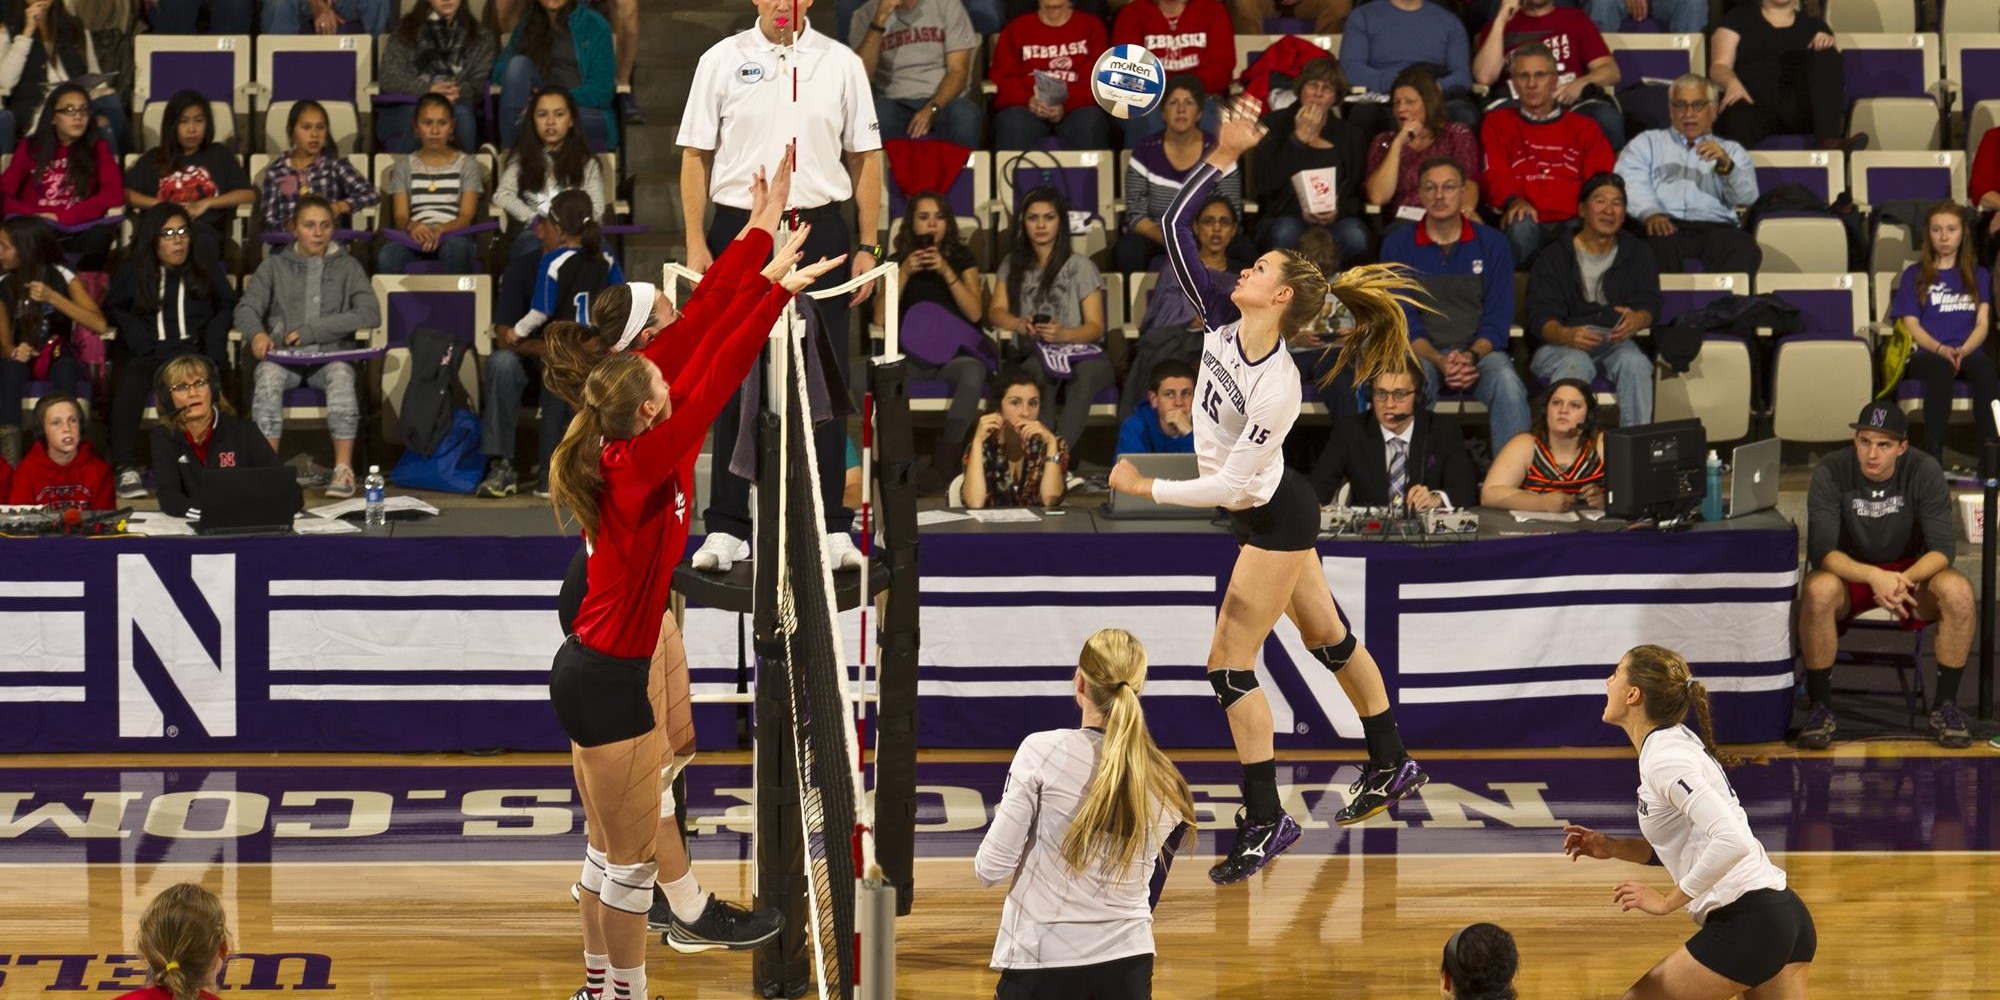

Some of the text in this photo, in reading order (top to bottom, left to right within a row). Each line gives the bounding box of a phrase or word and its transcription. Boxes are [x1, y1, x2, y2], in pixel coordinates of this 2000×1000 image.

[1022, 40, 1089, 61] NEBRASK
[1144, 32, 1207, 50] EBRASKA
[1110, 61, 1151, 77] molten
[573, 291, 592, 328] 1
[1202, 350, 1246, 416] NORTHWESTERN
[1201, 380, 1223, 425] 15
[1870, 408, 1888, 427] N
[1248, 424, 1271, 445] 15
[219, 451, 236, 467] N
[117, 553, 237, 738] N
[1676, 778, 1693, 795] 1
